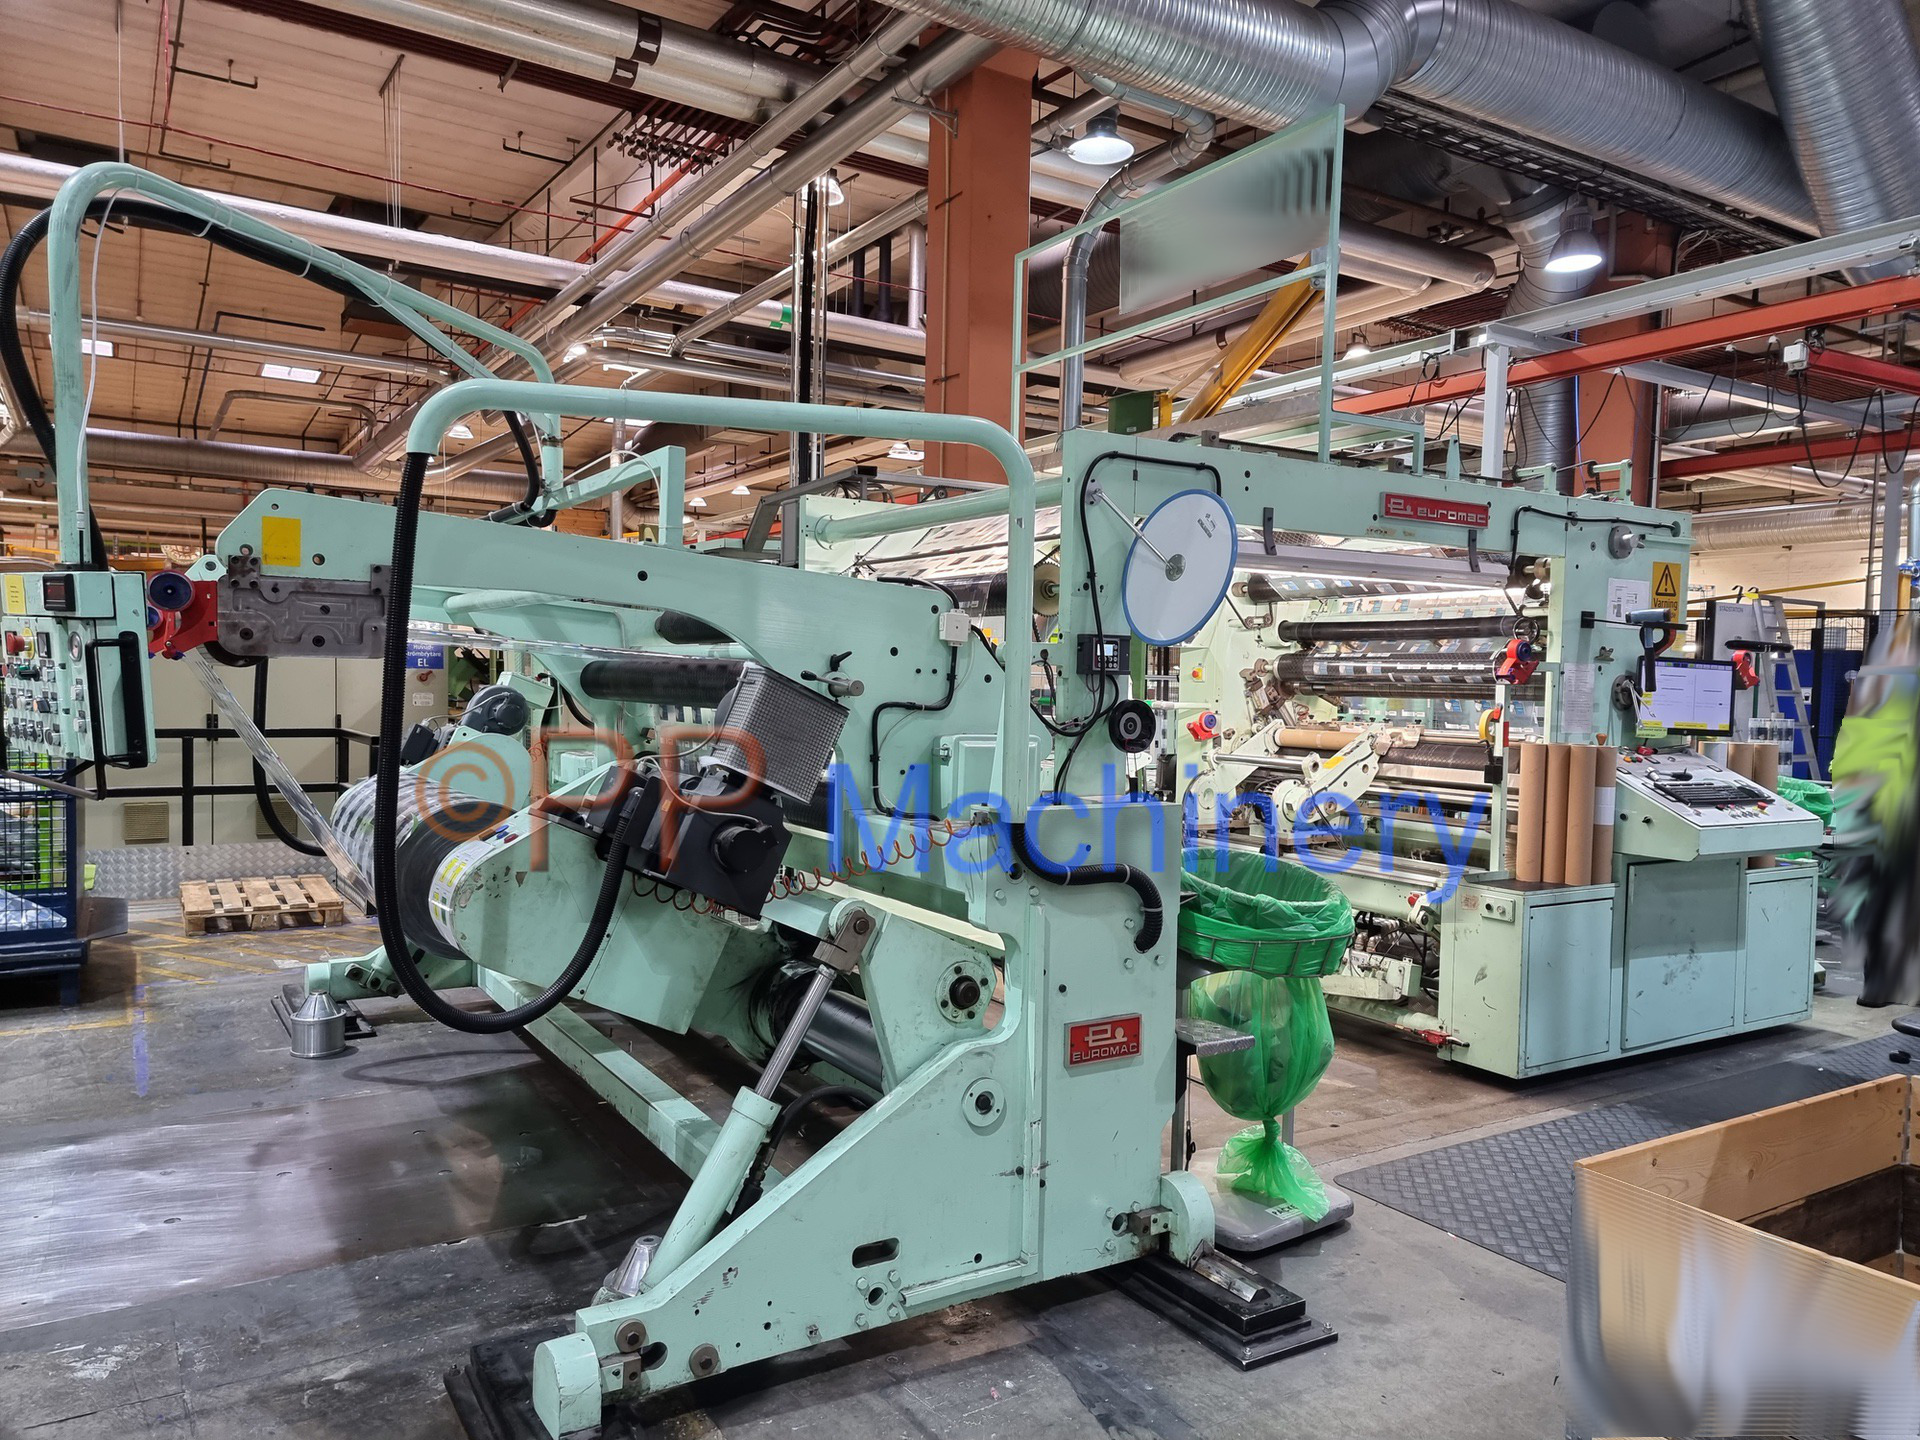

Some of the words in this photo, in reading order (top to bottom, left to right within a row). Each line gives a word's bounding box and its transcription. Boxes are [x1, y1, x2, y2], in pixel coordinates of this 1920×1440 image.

[1417, 507, 1486, 523] euromac
[1653, 598, 1678, 611] Varning
[417, 658, 429, 667] EL
[1072, 1042, 1138, 1062] EUROMAC
